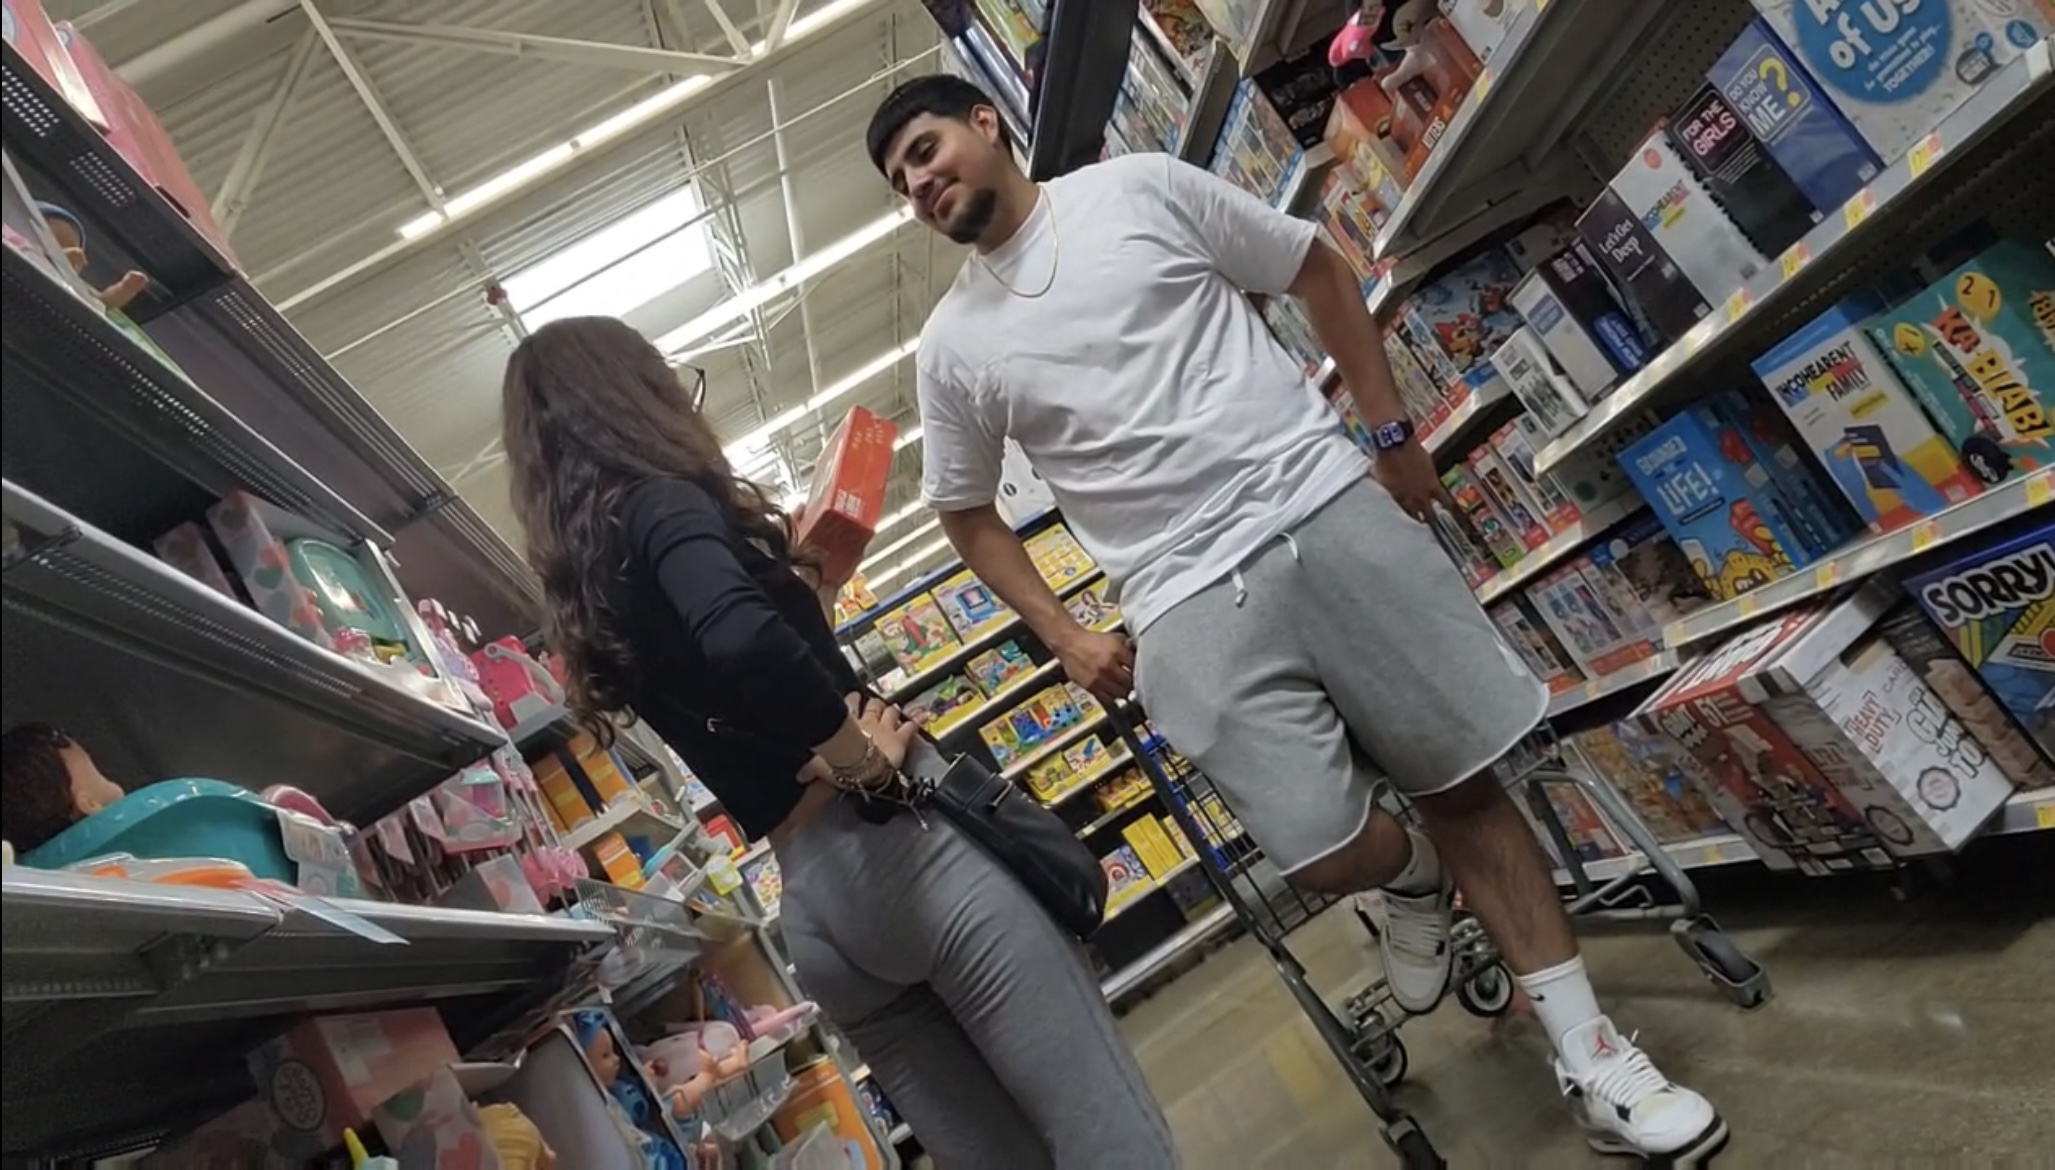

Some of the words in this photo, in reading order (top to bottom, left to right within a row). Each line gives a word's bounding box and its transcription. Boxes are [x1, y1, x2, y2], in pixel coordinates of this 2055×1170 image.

[1829, 11, 1872, 69] of
[1729, 85, 1743, 101] DO
[1740, 67, 1758, 89] YOU
[1739, 80, 1768, 112] KNOW
[1682, 119, 1705, 142] FOR
[1700, 99, 1725, 123] THE
[1693, 111, 1737, 156] GIRLS
[1748, 94, 1787, 136] ME
[1598, 231, 1620, 255] Let's
[1611, 235, 1643, 263] Deep
[1826, 367, 1872, 402] FAMILY
[1850, 697, 1881, 737] HEAVY
[1864, 707, 1895, 747] DUTY
